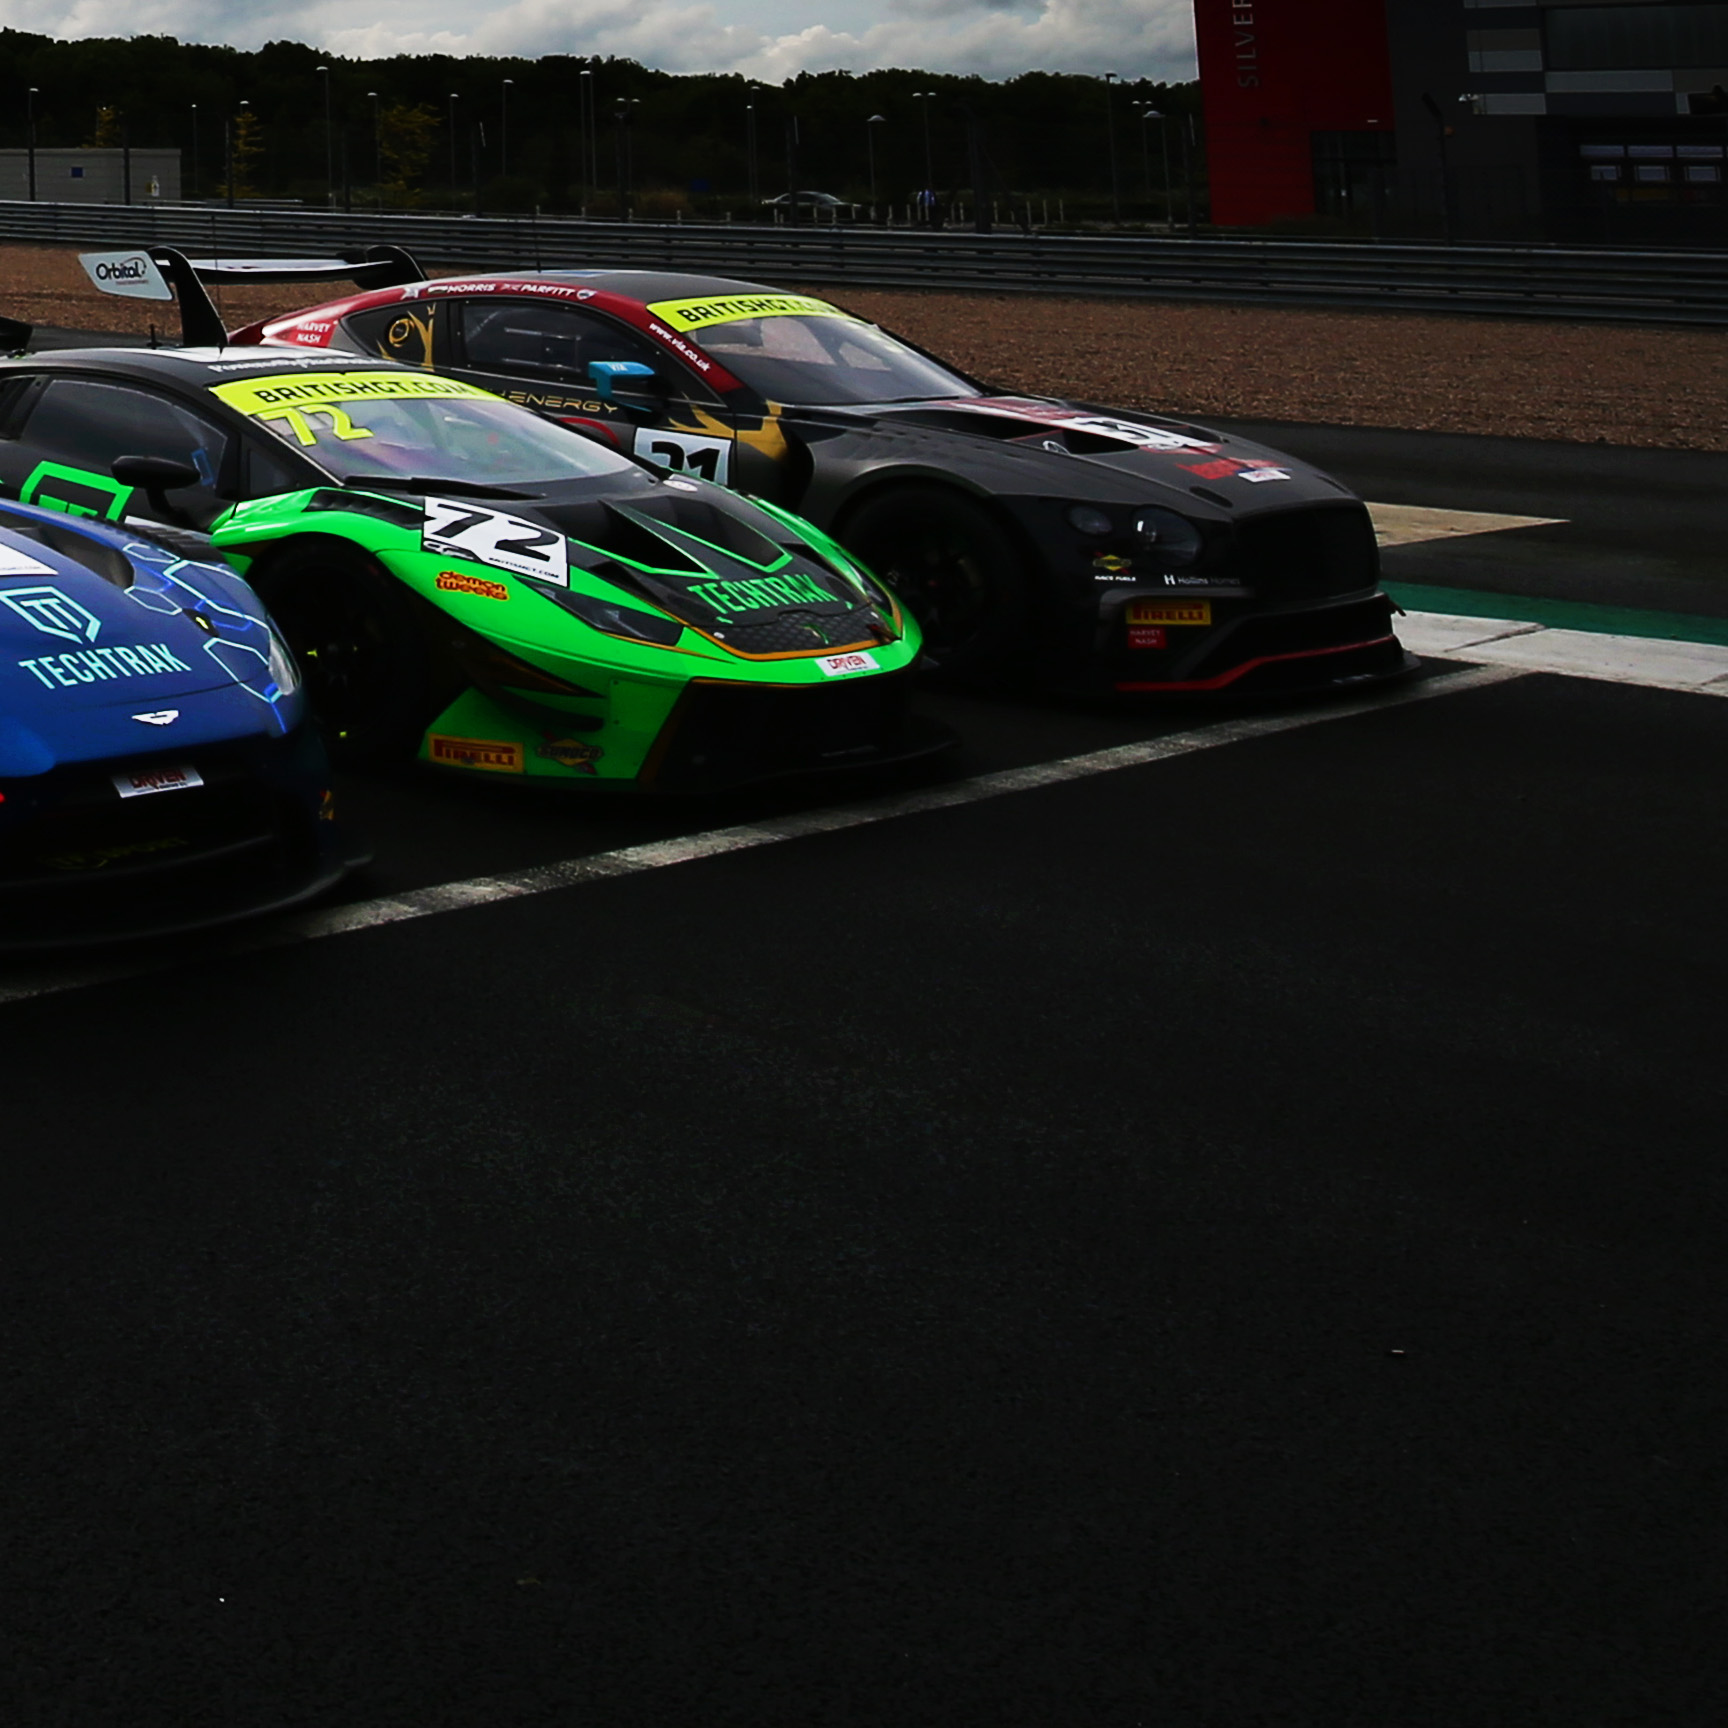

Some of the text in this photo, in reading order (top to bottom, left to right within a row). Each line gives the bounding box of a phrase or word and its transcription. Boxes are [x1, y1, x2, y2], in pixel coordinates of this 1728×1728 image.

[95, 259, 143, 281] Orbital
[447, 283, 497, 294] MORRIS
[521, 283, 575, 297] PARFITT
[296, 322, 332, 333] HARVEY
[297, 333, 321, 344] NASH
[649, 322, 711, 372] www.via.co.uk
[253, 380, 476, 403] BRITISHGT.COM
[257, 402, 375, 448] 72
[430, 502, 560, 563] 72
[438, 570, 507, 593] demon
[1178, 576, 1209, 585] Hollins
[685, 573, 840, 615] TECHTRAK
[1132, 602, 1205, 622] PIRELLI
[18, 642, 192, 690] TECHTRAK
[826, 655, 869, 672] DRIVEN
[433, 738, 516, 766] PIRELLI
[129, 768, 187, 789] DRIVEN
